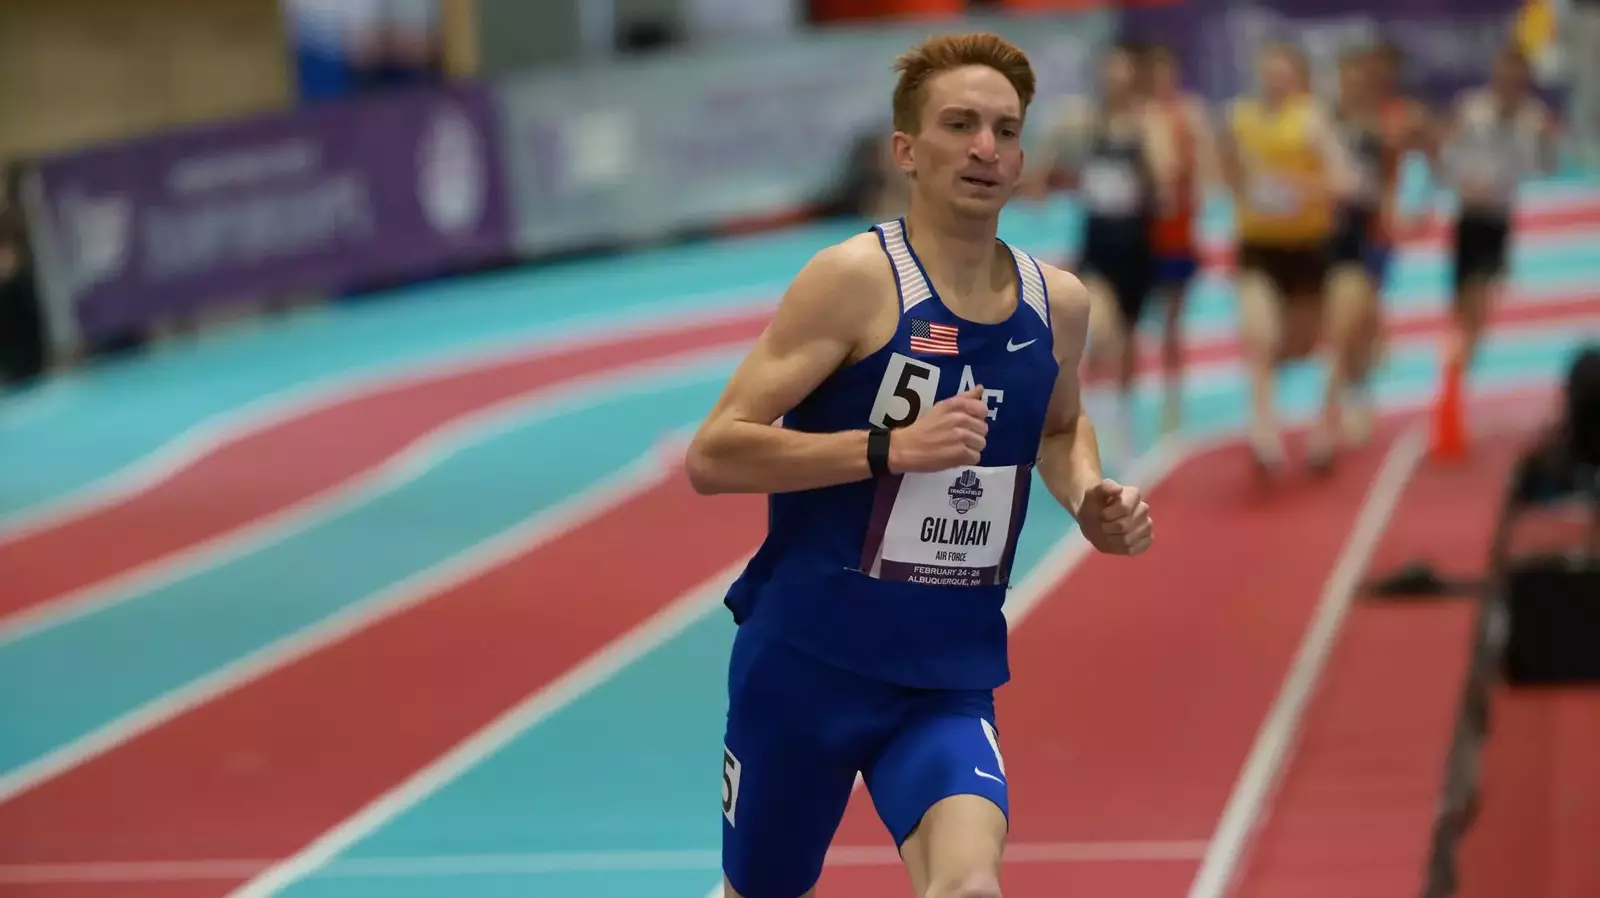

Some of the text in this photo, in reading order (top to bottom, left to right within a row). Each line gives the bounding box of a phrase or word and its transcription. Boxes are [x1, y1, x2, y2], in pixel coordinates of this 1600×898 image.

[882, 362, 931, 428] 5
[956, 365, 1004, 421] AF
[920, 516, 991, 546] GILMAN
[914, 566, 957, 576] FEBRUARY
[935, 550, 967, 562] AIR FORCE
[908, 575, 969, 586] ALBUQUERQUE,
[722, 750, 735, 813] 5
